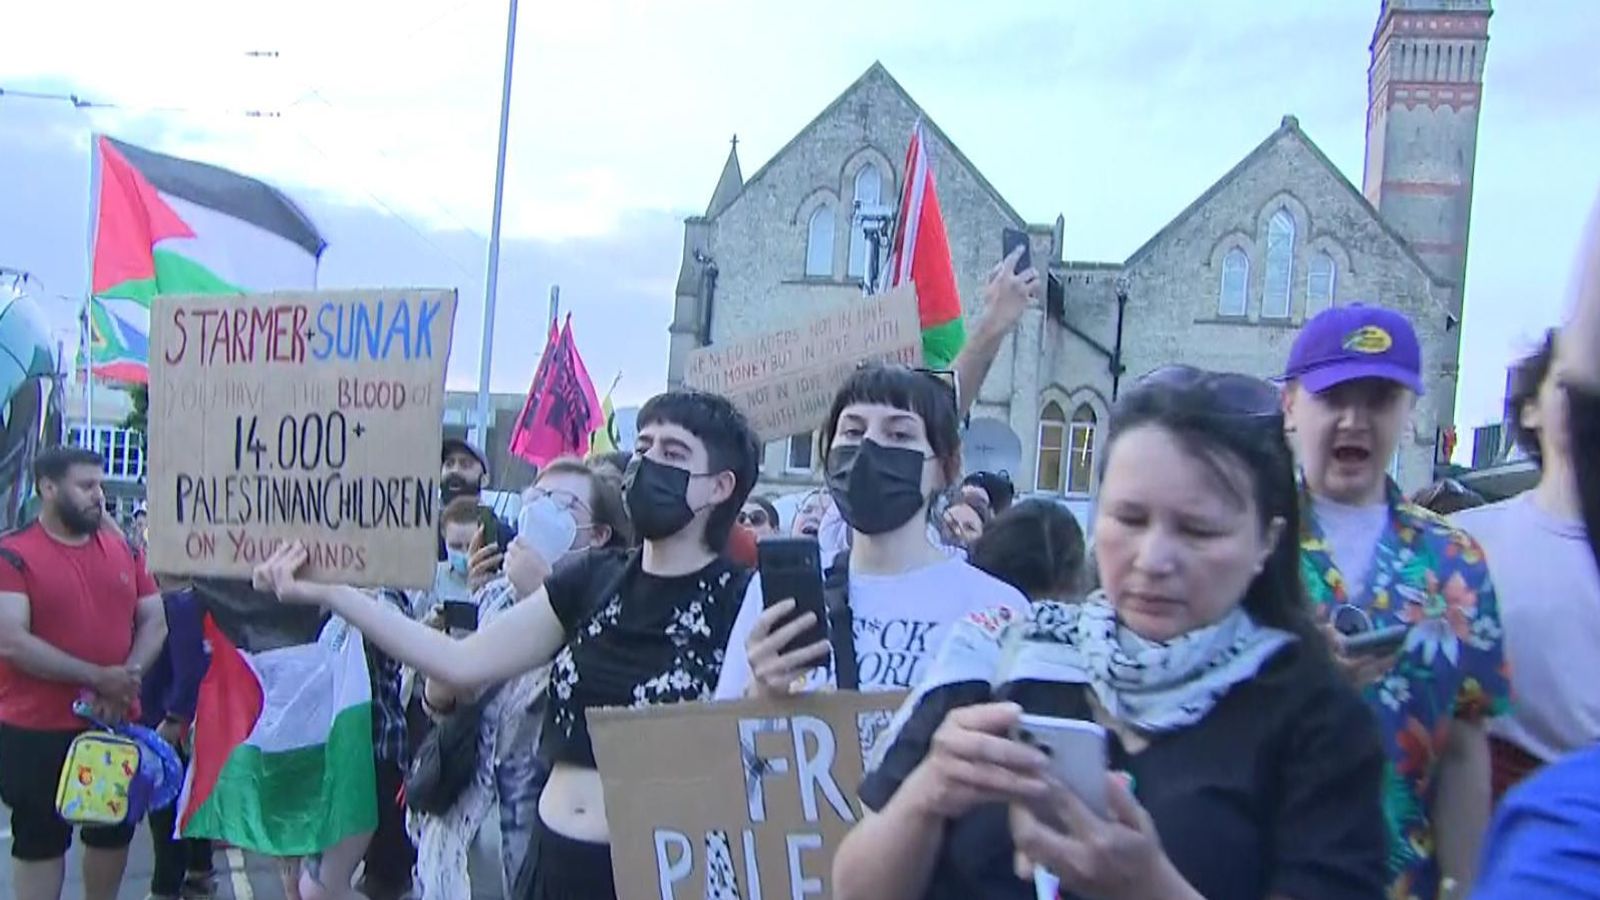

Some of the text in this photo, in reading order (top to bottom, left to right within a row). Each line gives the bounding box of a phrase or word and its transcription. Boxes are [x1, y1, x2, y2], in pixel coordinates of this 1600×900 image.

[165, 304, 307, 366] STARMER
[312, 299, 441, 361] SUNAK
[723, 358, 766, 386] MONEY
[770, 350, 792, 371] BUT
[801, 343, 816, 362] IN
[820, 334, 850, 358] LOVE
[863, 319, 899, 348] WITH
[337, 376, 406, 411] BLOOD
[746, 384, 770, 409] NOT
[186, 531, 216, 561] ON
